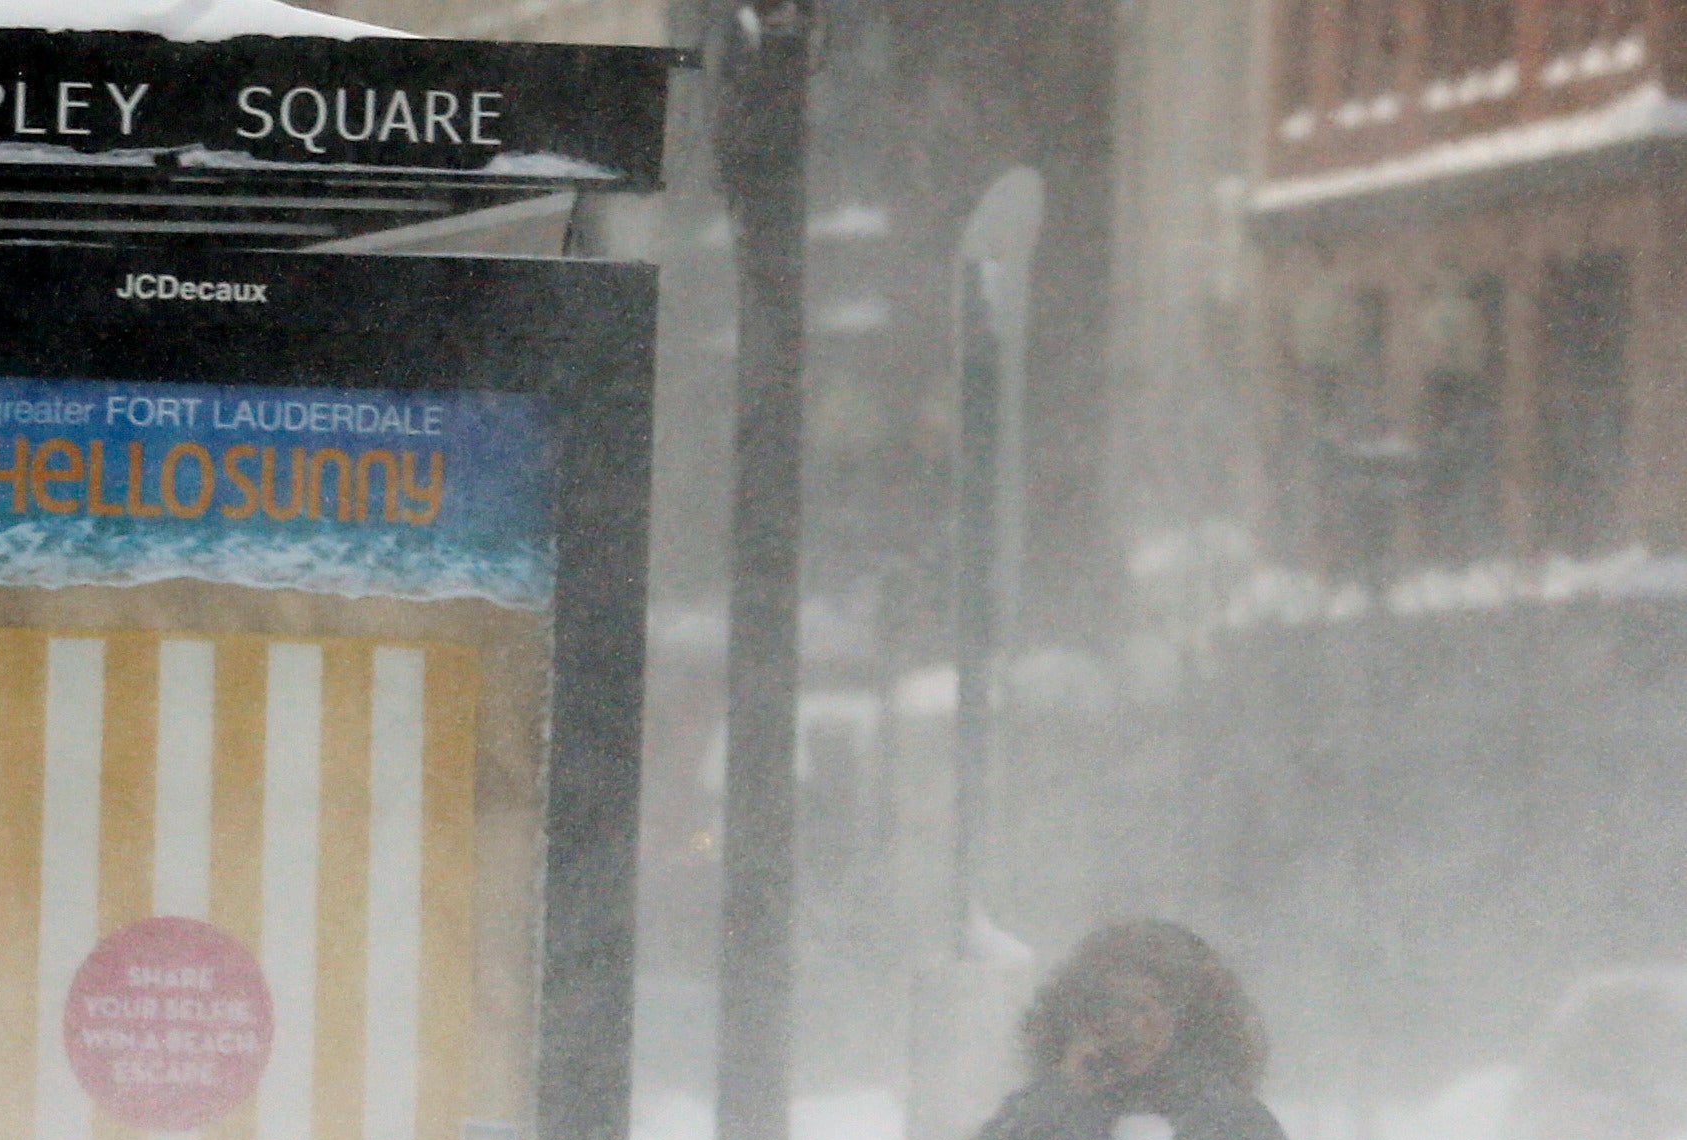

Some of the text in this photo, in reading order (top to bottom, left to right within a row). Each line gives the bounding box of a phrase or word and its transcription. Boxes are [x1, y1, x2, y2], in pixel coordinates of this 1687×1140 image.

[237, 85, 503, 153] SQUARE
[116, 273, 269, 305] JCDecaux
[106, 396, 201, 428] FORT
[214, 402, 442, 436] LAUDERDALE
[127, 966, 214, 990] SHARE
[84, 996, 158, 1018] YOUR
[165, 1029, 258, 1054] BEACH
